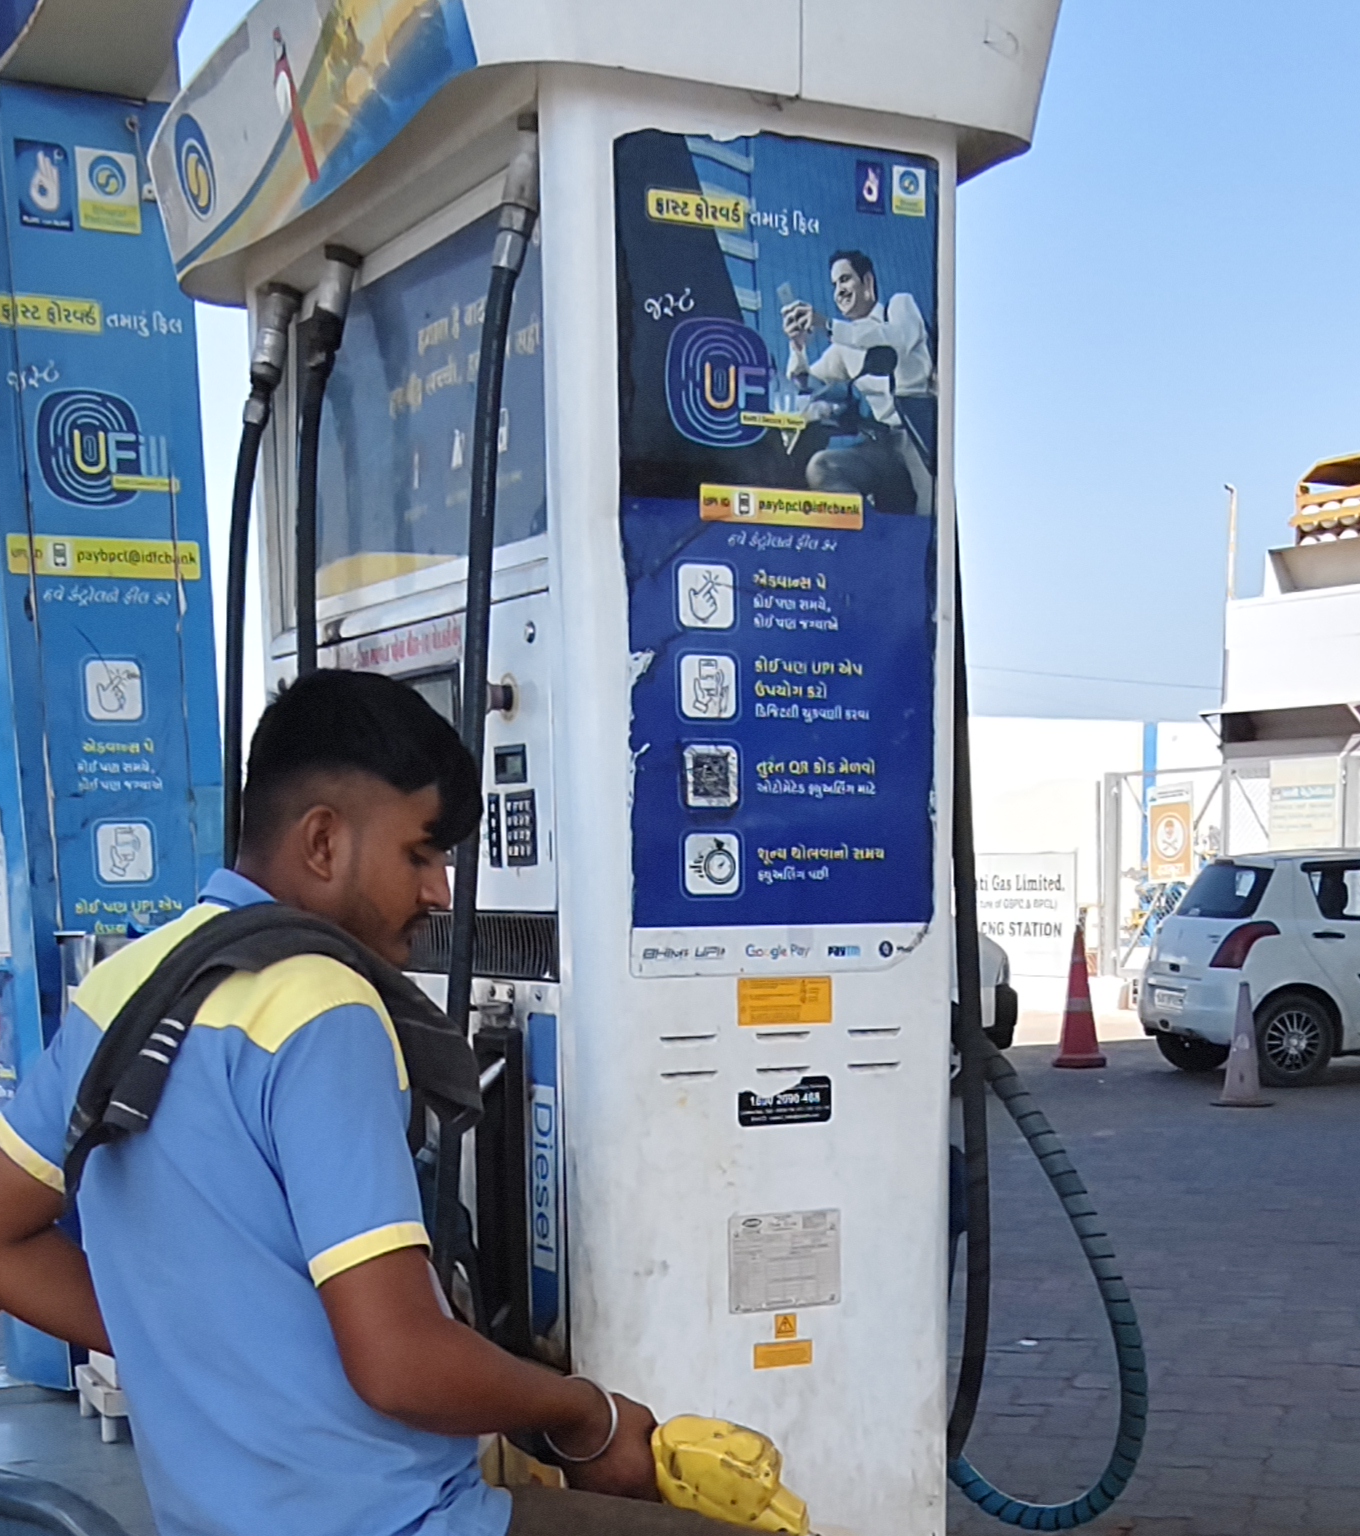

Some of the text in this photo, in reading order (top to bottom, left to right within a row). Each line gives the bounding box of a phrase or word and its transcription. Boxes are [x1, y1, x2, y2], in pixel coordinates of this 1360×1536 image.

[654, 194, 821, 236] ફાસ્ટ ફોરવર્ડ તમારું ફિલ
[106, 309, 150, 337] તમારું
[153, 312, 183, 335] ફિલ
[992, 875, 1011, 891] Gas
[980, 922, 1062, 936] CNG STATION
[746, 944, 811, 960] Google Pay
[532, 1102, 555, 1262] Diesel
